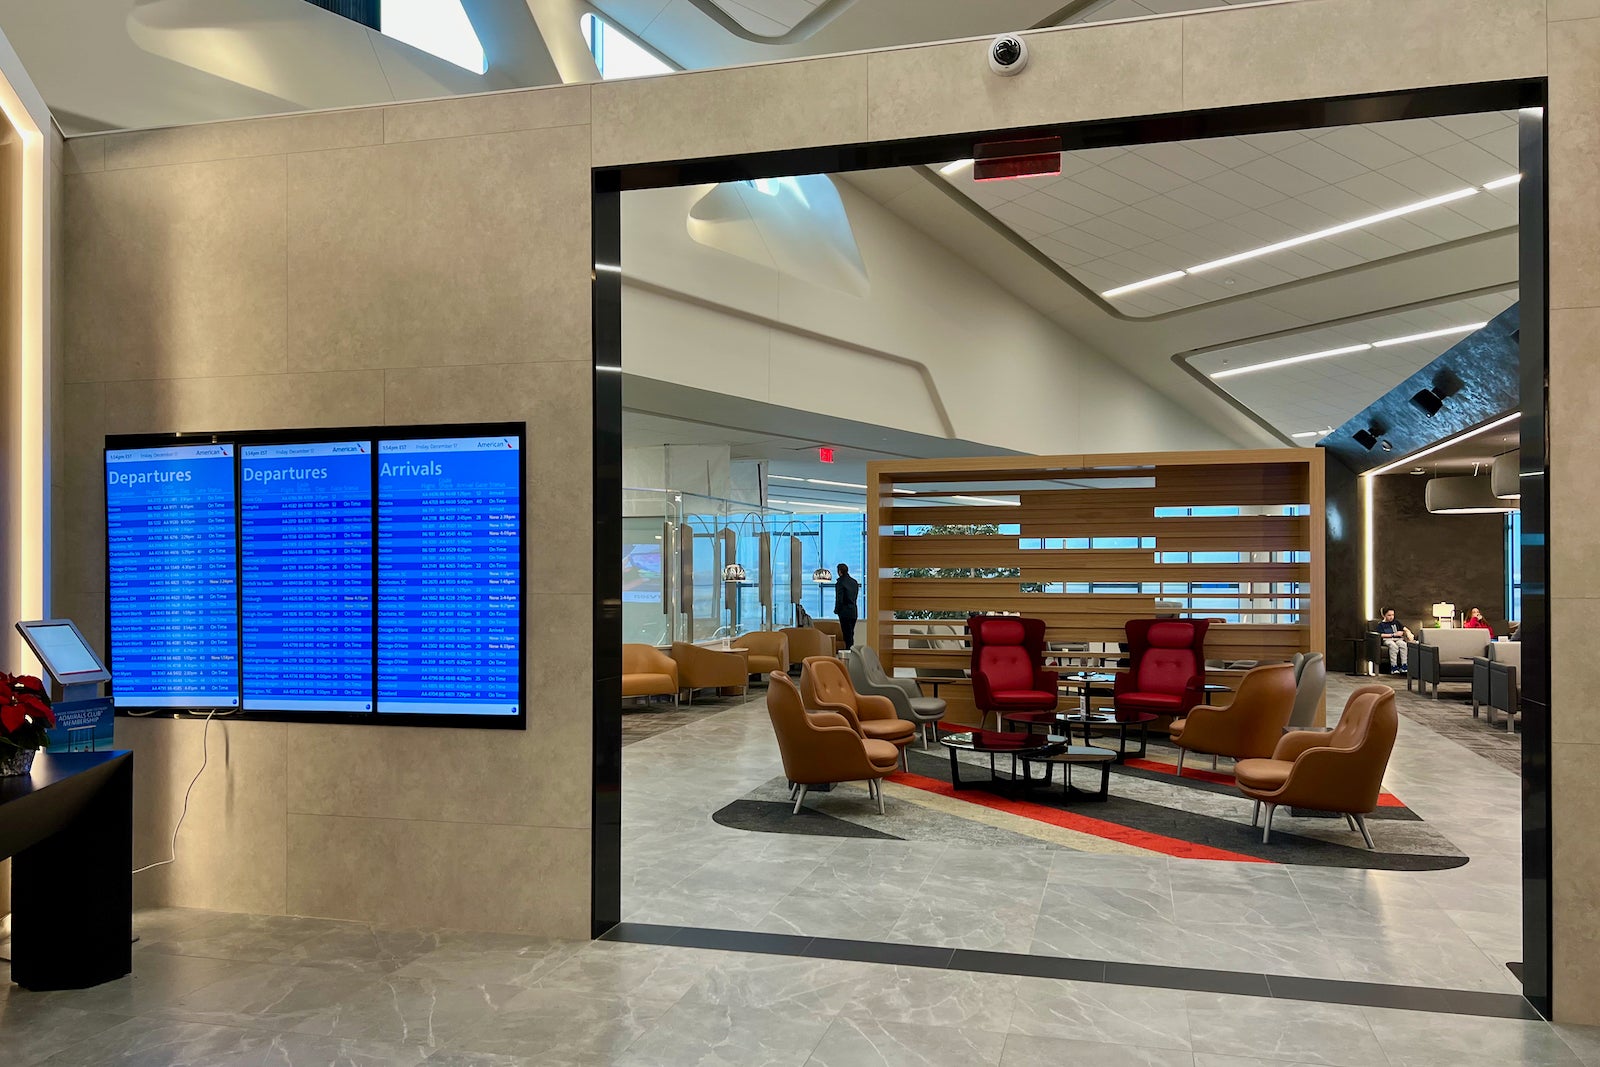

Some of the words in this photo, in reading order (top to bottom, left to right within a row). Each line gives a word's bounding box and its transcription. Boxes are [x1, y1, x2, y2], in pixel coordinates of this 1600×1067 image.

[243, 465, 327, 485] Departures
[380, 460, 442, 476] Arrivals
[109, 468, 192, 488] Departures
[58, 711, 86, 721] ADMIRALS
[63, 717, 99, 727] MEMBERSHIP
